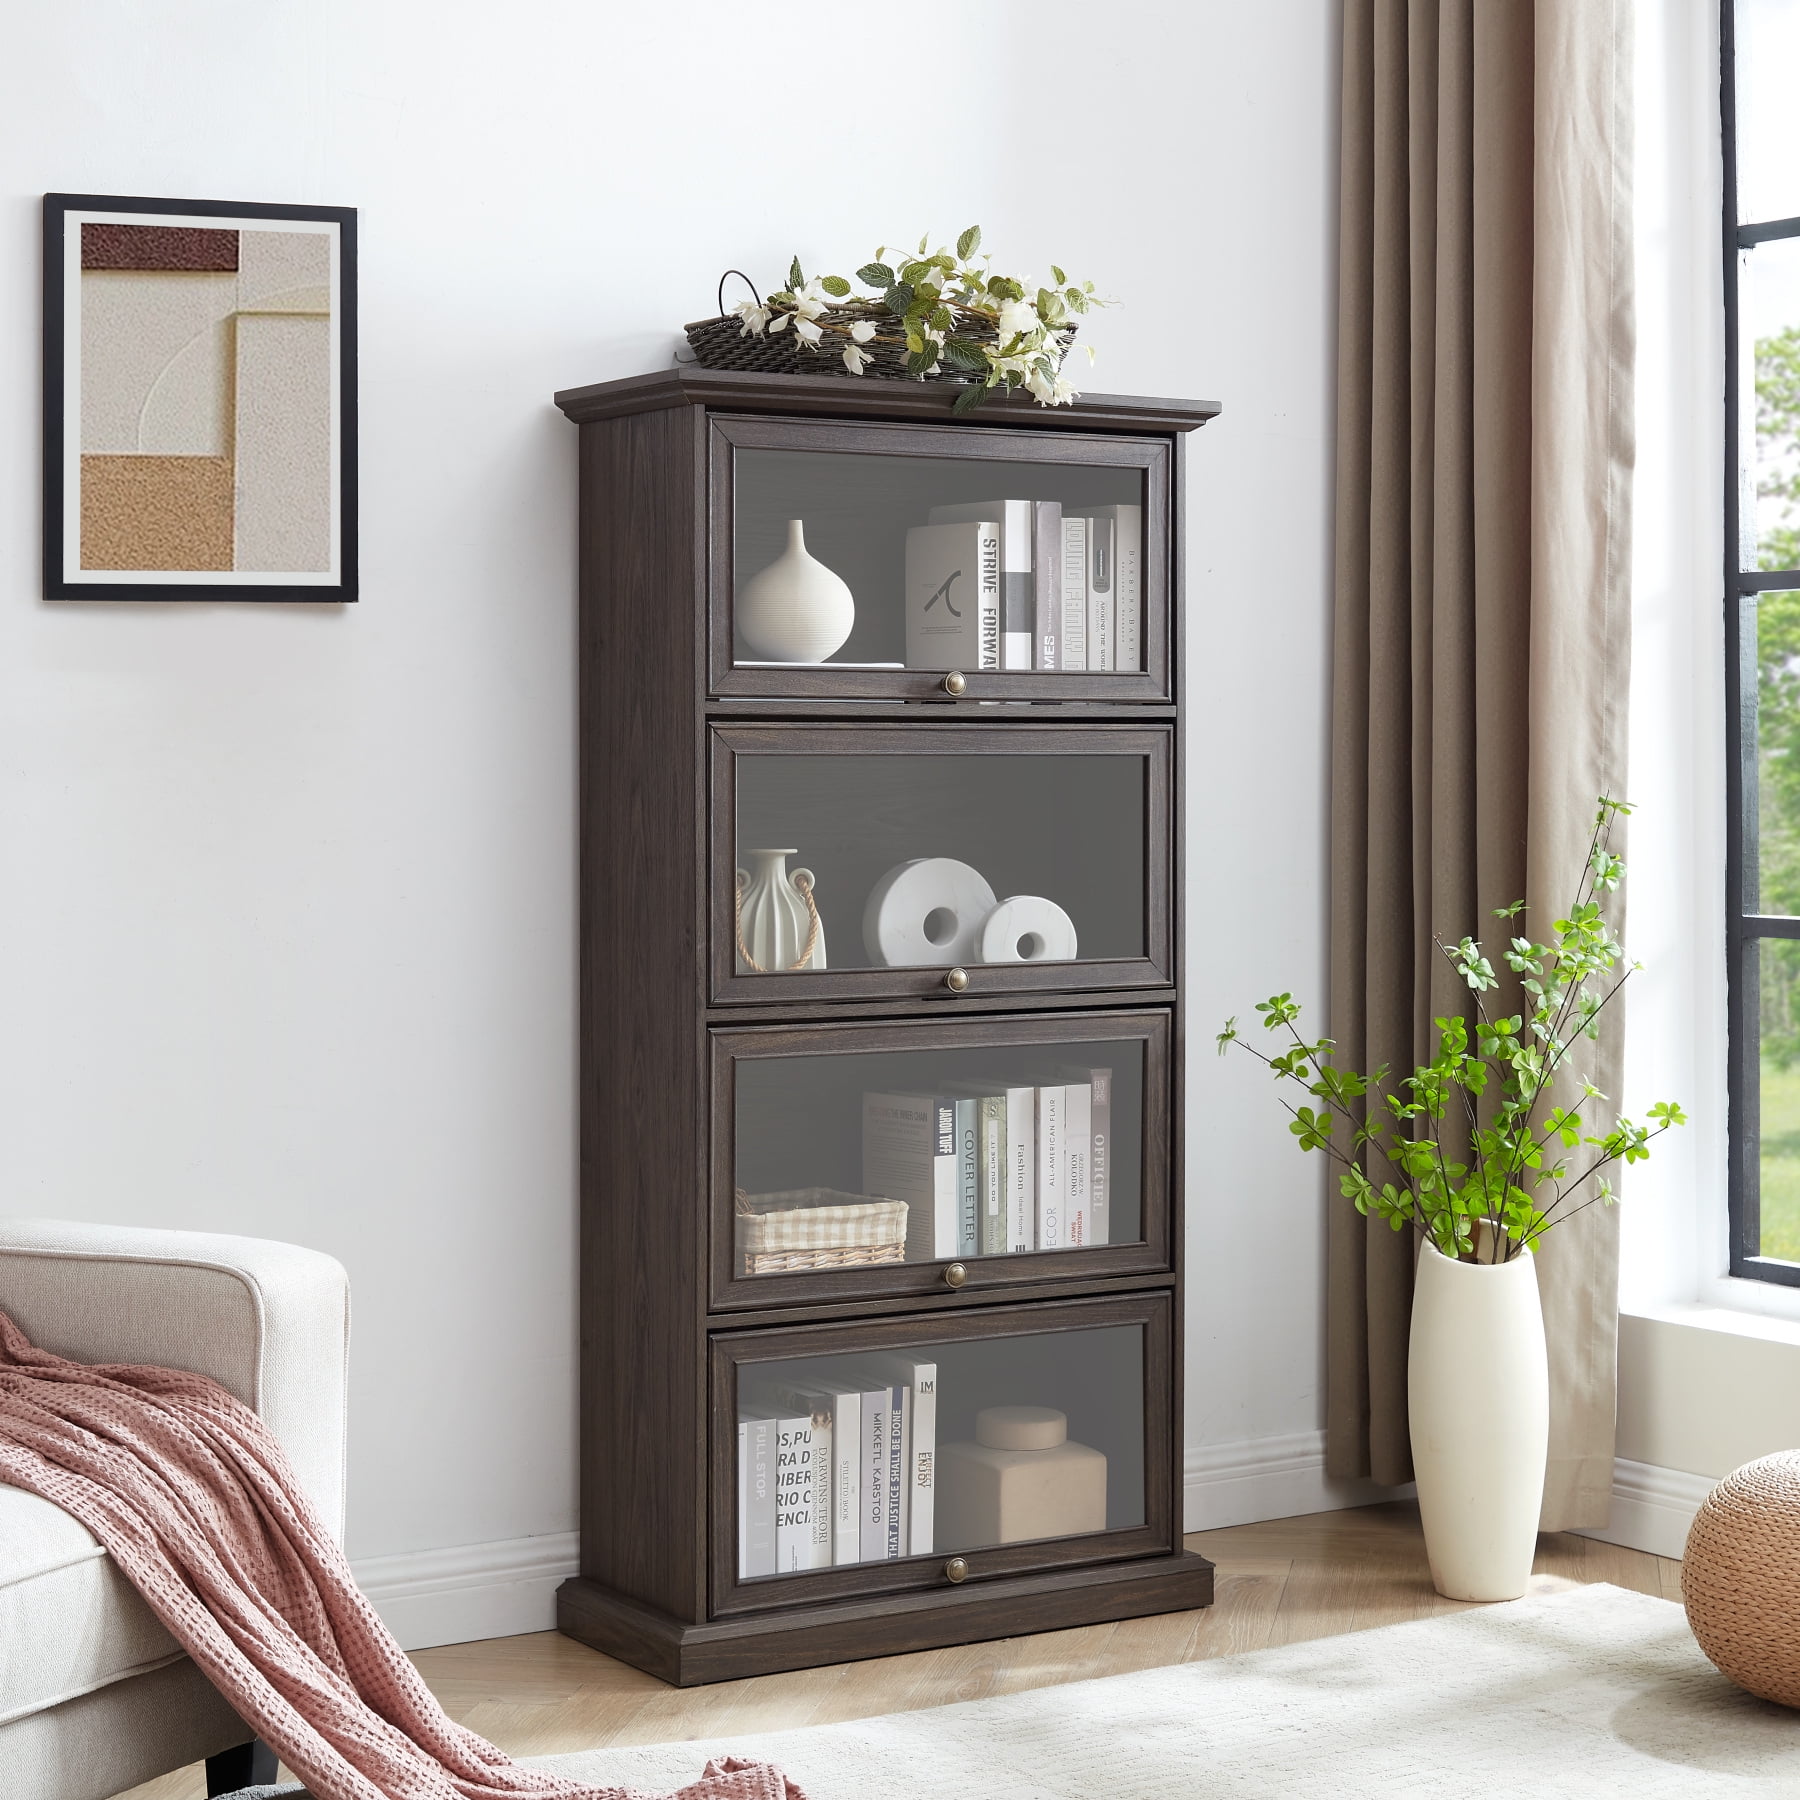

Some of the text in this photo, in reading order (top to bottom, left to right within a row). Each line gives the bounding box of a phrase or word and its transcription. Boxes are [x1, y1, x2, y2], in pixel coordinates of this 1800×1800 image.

[982, 538, 997, 594] STRIVE
[1043, 635, 1055, 669] MES
[938, 1135, 953, 1154] TUFF
[1017, 1144, 1025, 1190] Fashion
[964, 1129, 976, 1241] COVER LETTER
[1093, 1134, 1105, 1212] OFFICIEL
[1046, 1207, 1057, 1250] ECOR
[920, 1381, 934, 1393] IM
[756, 1425, 768, 1501] FULL STOP.
[871, 1412, 882, 1523] MIKKETL KARSTOD
[888, 1409, 902, 1558] THAT JUSTICE SHALL BE DONE
[776, 1510, 812, 1528] ENCI
[818, 1447, 828, 1545] DARWINS TEORI
